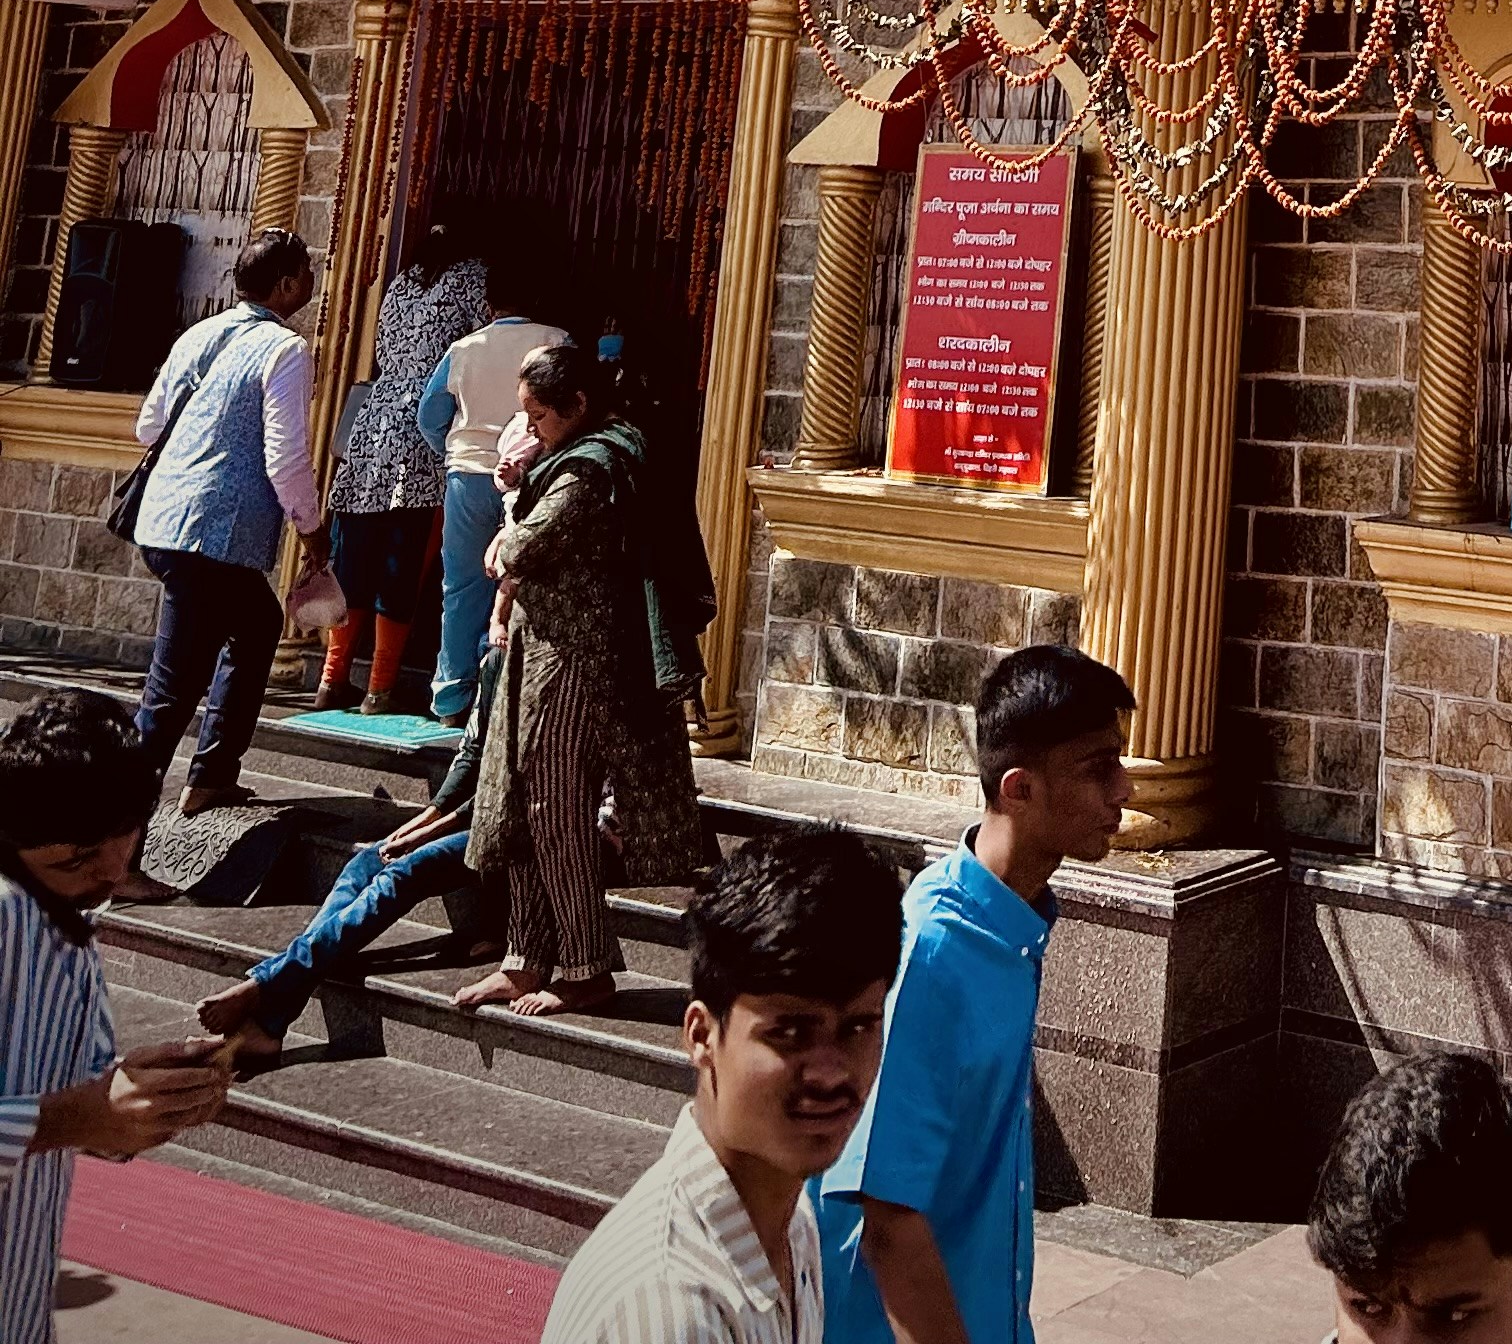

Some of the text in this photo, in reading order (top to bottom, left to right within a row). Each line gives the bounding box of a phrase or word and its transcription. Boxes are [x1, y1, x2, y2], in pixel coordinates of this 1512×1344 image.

[949, 167, 986, 182] समय
[923, 197, 1060, 221] मन्दिर पूजा अर्चना का समय
[959, 255, 974, 268] बजे
[976, 255, 984, 269] से
[1007, 257, 1023, 269] बजे
[991, 278, 1005, 290] बजे
[936, 294, 952, 307] बजे
[955, 295, 963, 307] से
[1011, 298, 1029, 311] बजे
[1031, 300, 1049, 311] तक
[938, 334, 1011, 353] शरदकालीन
[950, 358, 966, 371] बजे
[967, 359, 976, 372] से
[1000, 363, 1016, 376] बजे
[983, 382, 997, 394] बजे
[926, 397, 943, 410] बजे
[945, 399, 953, 412] से
[1002, 404, 1019, 416] बजे
[1021, 406, 1038, 417] तक
